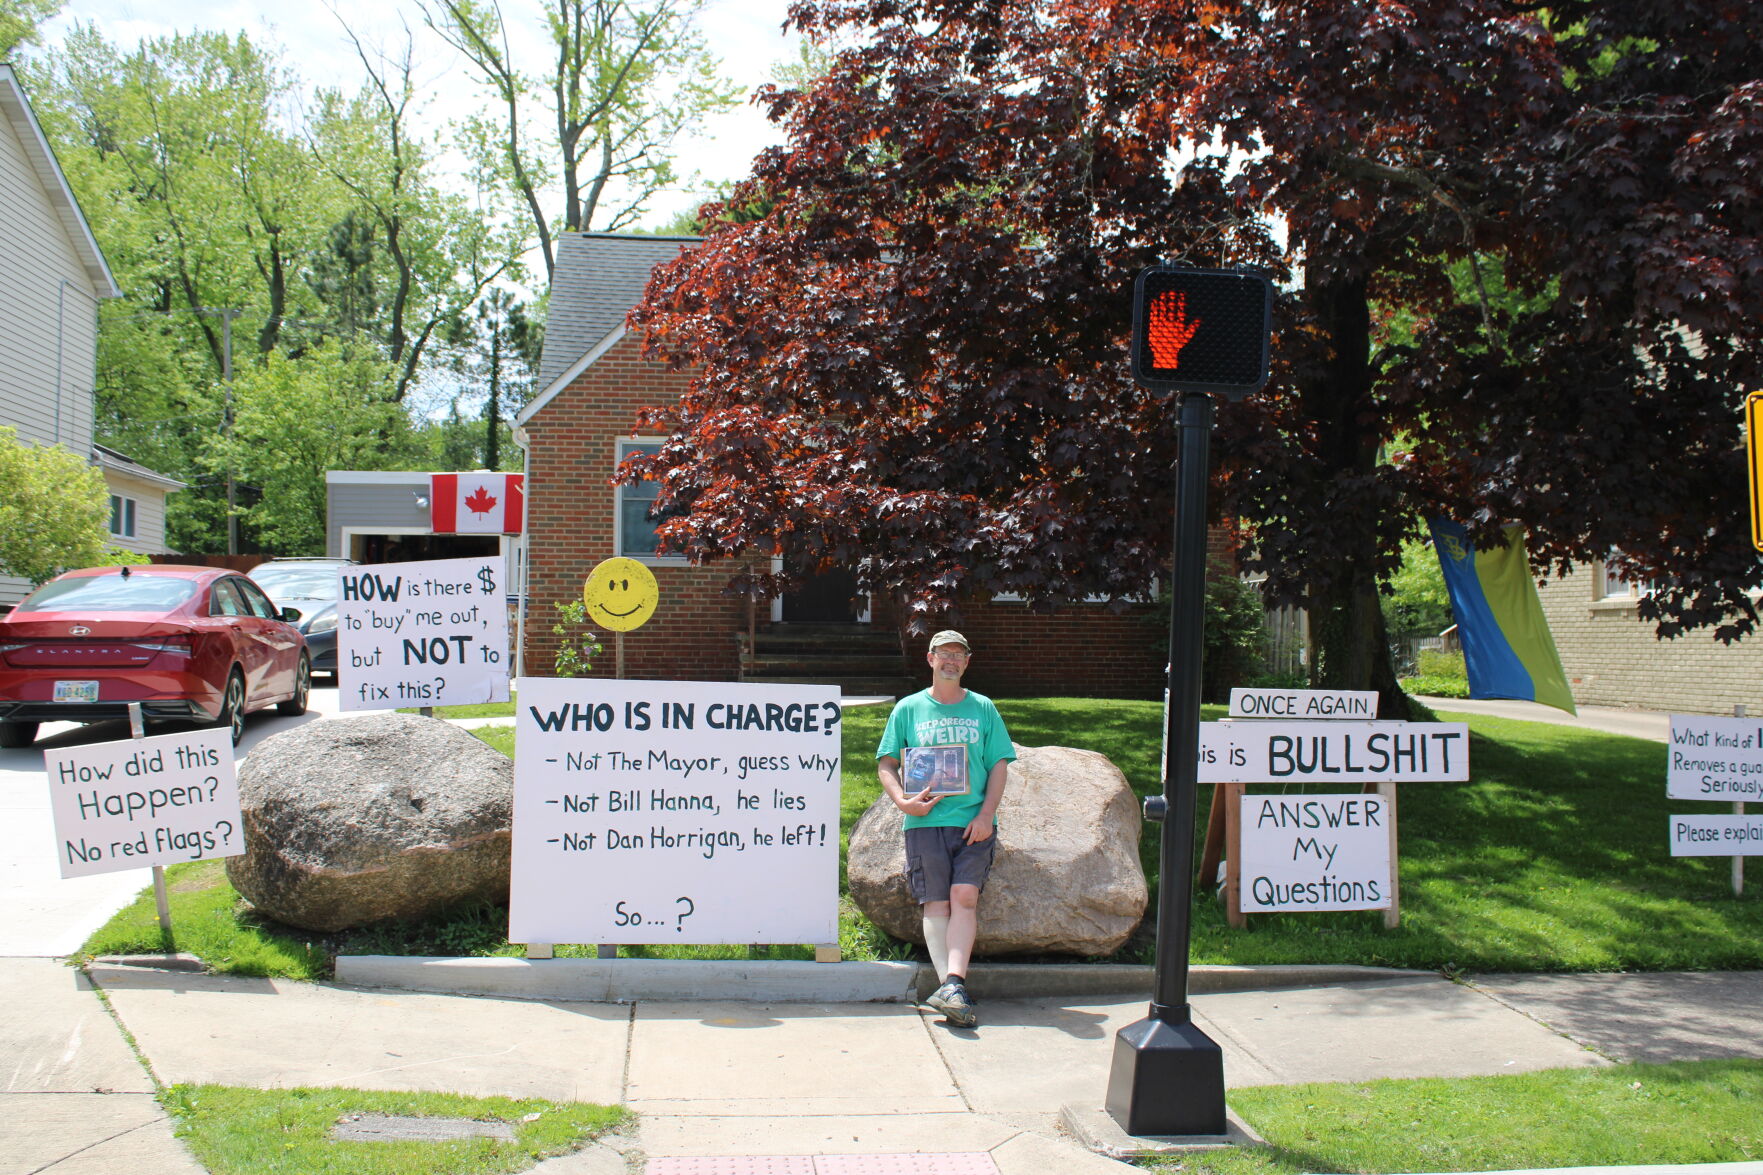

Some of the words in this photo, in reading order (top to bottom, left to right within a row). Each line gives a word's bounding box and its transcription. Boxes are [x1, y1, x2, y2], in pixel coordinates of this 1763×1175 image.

[342, 573, 402, 602] HOW
[408, 580, 420, 596] is
[424, 579, 472, 596] there
[477, 565, 496, 595] $
[345, 614, 362, 630] to
[416, 611, 442, 626] me
[450, 605, 488, 629] out,
[352, 646, 382, 667] but
[402, 636, 473, 665] NOT
[480, 645, 499, 663] to
[359, 682, 389, 701] fix
[397, 677, 445, 700] this?
[530, 703, 614, 731] WHO
[625, 702, 651, 730] IS
[662, 703, 694, 729] IN
[706, 702, 841, 735] CHARGE?
[1240, 694, 1297, 715] ONCE
[915, 720, 938, 731] KEEP
[940, 718, 979, 726] OREGON
[917, 726, 979, 745] WEIRD
[1672, 728, 1709, 747] What
[1715, 732, 1738, 747] kind
[1741, 735, 1752, 748] of
[59, 760, 114, 784] How
[125, 749, 163, 776] did
[175, 745, 219, 769] this
[566, 752, 602, 771] Not
[607, 752, 642, 770] The
[648, 750, 727, 778] Mayor,
[738, 756, 790, 779] guess
[1230, 742, 1246, 766] is
[1268, 732, 1461, 776] BULLSHIT
[1674, 752, 1725, 772] Removes
[1729, 763, 1736, 772] a
[1740, 764, 1762, 776] gua
[78, 776, 218, 821] Happen?
[609, 791, 640, 812] Bill
[651, 789, 720, 815] Hanna,
[737, 790, 759, 810] he
[773, 789, 806, 810] lies
[1257, 800, 1380, 829] ANSWER
[66, 838, 101, 864] No
[111, 832, 148, 857] red
[155, 820, 232, 859] flags?
[607, 830, 643, 849] Dan
[651, 826, 745, 859] Horrigan,
[754, 828, 773, 846] he
[782, 824, 826, 847] left!
[1677, 823, 1719, 842] Please
[1724, 822, 1763, 844] explai
[1293, 837, 1338, 871] My
[1253, 875, 1381, 906] Questions
